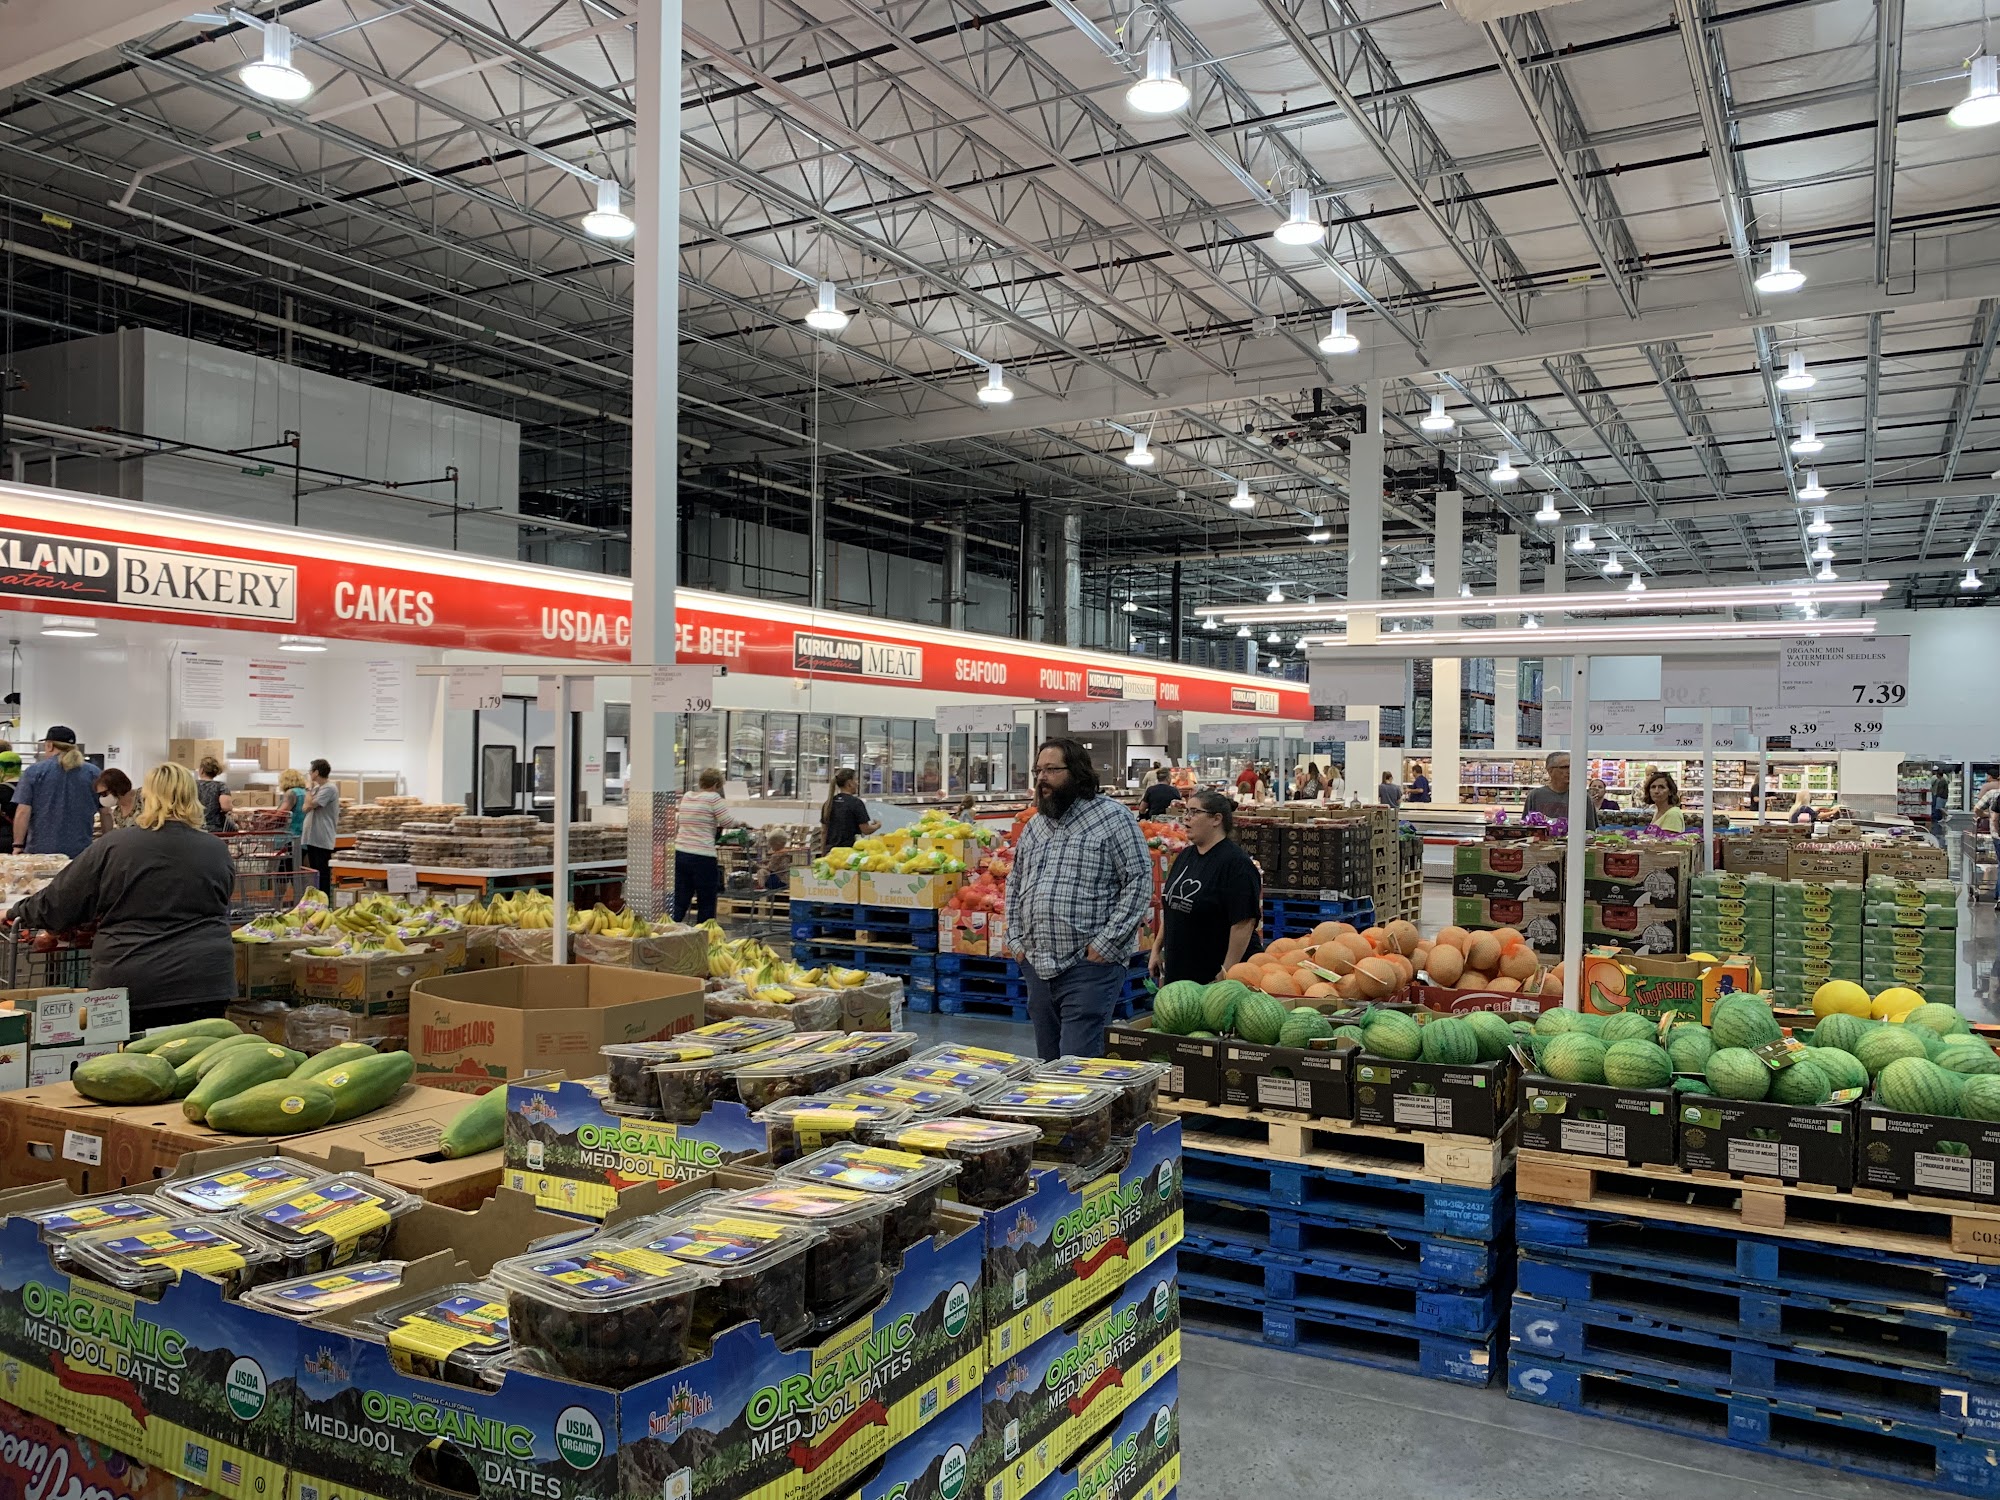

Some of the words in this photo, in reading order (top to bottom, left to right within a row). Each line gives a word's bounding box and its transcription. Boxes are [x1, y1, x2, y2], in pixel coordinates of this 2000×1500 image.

[0, 572, 107, 593] ature
[123, 557, 288, 609] BAKERY
[334, 581, 434, 627] CAKES
[541, 607, 608, 645] USDA
[699, 626, 746, 658] BEEF
[798, 637, 861, 661] KIRKLAND
[797, 655, 860, 669] Signature
[867, 646, 917, 676] MEAT
[955, 658, 1007, 685] SEAFOOD
[1040, 668, 1082, 692] POULTRY
[1088, 673, 1123, 689] KIRKLAND
[1124, 681, 1155, 695] ROTISSERIE
[1160, 682, 1180, 702] PORK
[1851, 684, 1906, 704] 7.39
[478, 696, 501, 709] 1.79
[684, 698, 711, 712] 3.99
[1259, 693, 1275, 711] DELI
[956, 724, 973, 733] 6.19
[995, 723, 1012, 732] 4.79
[1091, 721, 1110, 730] 8.99
[1134, 720, 1153, 729] 6.99
[1638, 723, 1663, 734] 7.49
[1789, 723, 1817, 735] 8.39
[1854, 722, 1883, 733] 8.99
[1715, 739, 1733, 747] 6.99
[1815, 740, 1834, 748] 6.19
[808, 887, 839, 897] LEMONS
[880, 895, 913, 905] LEMONS
[83, 992, 120, 1004] Organic
[1635, 982, 1696, 1007] KingFISHER
[42, 1004, 67, 1017] KENT
[69, 1003, 74, 1013] 6
[433, 1011, 451, 1026] Fresh
[624, 1019, 647, 1035] Fresh
[422, 1021, 495, 1054] WATERMELONS
[76, 1050, 111, 1059] Organic
[1442, 1077, 1472, 1085] WATERMELON
[1615, 1104, 1649, 1112] WATERMELON
[621, 1121, 646, 1131] PREMIUM
[646, 1124, 676, 1135] CALIFORNIA
[1787, 1122, 1826, 1131] WATERMELON
[1887, 1125, 1924, 1135] CANTALOUPE
[577, 1123, 724, 1168] ORGANIC
[579, 1150, 659, 1178] MEDJOOL
[1951, 1157, 1965, 1165] U.S.A.
[1951, 1165, 1970, 1173] MEXICO
[1052, 1176, 1144, 1249] ORGANIC
[1463, 1211, 1472, 1221] OF
[1472, 1212, 1490, 1222] CHEP
[1054, 1230, 1107, 1270] MEDJOOL
[1109, 1205, 1142, 1238] DATES
[71, 1284, 100, 1299] PREMIUM
[100, 1293, 133, 1311] CALIFORNIA
[948, 1294, 965, 1311] USDA
[22, 1279, 189, 1370] ORGANIC
[945, 1308, 967, 1329] ORGANIC
[1525, 1320, 1559, 1345] C
[23, 1317, 113, 1373] MEDJOOL
[116, 1352, 181, 1396] DATES
[814, 1348, 840, 1369] PREMIUM
[840, 1326, 872, 1354] CALIFORNIA
[1045, 1302, 1139, 1392] ORGANIC
[234, 1369, 259, 1390] USDA
[746, 1311, 916, 1431] ORGANIC
[1048, 1359, 1101, 1412] MEDJOOL
[1104, 1332, 1137, 1368] DATES
[1518, 1368, 1554, 1395] C
[229, 1389, 261, 1408] ORGANIC
[411, 1392, 439, 1405] PREMIUM
[439, 1398, 476, 1414] CALIFORNIA
[751, 1397, 856, 1461] MEDJOOL
[859, 1351, 912, 1400] DATES
[1976, 1408, 1987, 1417] OF
[361, 1389, 537, 1461] ORGANIC
[566, 1418, 594, 1439] USDA
[648, 1409, 668, 1437] Sun
[303, 1411, 404, 1458] MEDJOOL
[561, 1437, 598, 1457] ORGANIC
[0, 1428, 69, 1500] Vine
[793, 1459, 843, 1492] PRESERVATIVES
[858, 1428, 886, 1449] ADDITIVES
[944, 1456, 962, 1475] USDA
[484, 1460, 562, 1499] DATES
[942, 1470, 966, 1491] ORGANIC
